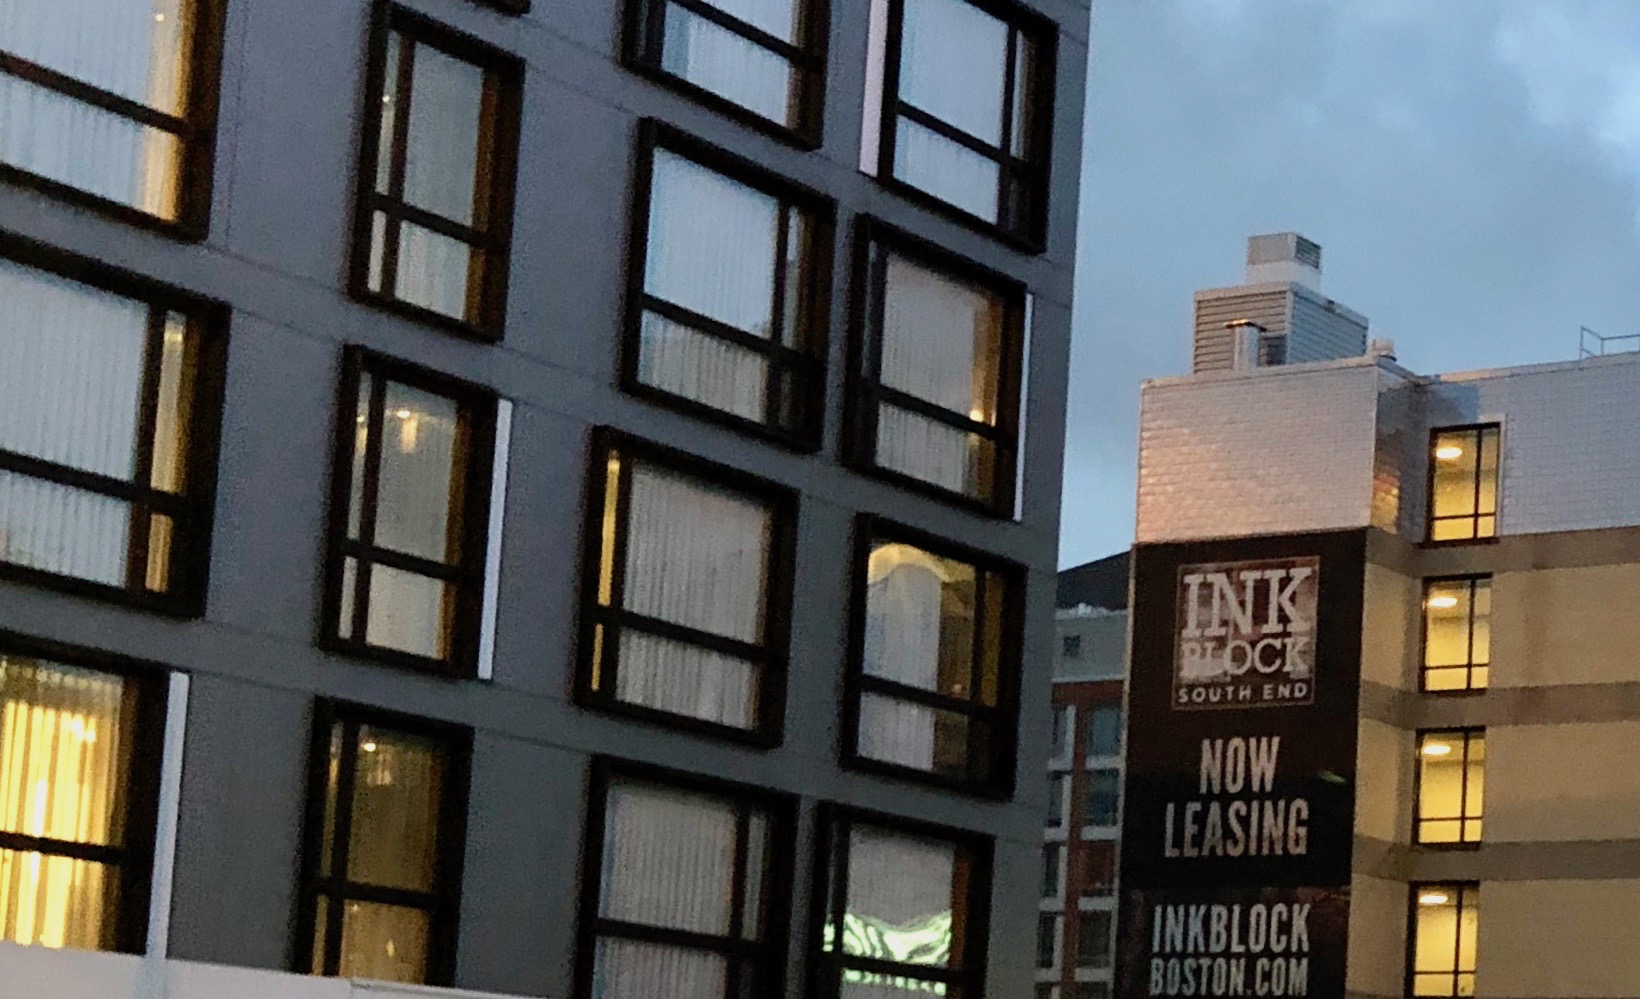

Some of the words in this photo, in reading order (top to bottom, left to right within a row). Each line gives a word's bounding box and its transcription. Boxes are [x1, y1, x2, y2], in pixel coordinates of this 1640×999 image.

[1181, 567, 1312, 638] INK
[1179, 637, 1311, 680] BLOCK
[1178, 683, 1250, 703] SOUTH
[1262, 681, 1308, 700] END
[1199, 736, 1281, 794] NOW
[1164, 798, 1309, 858] LEASING
[1152, 902, 1311, 954] INKBLOCK
[1149, 957, 1309, 997] BOSTON.COM
